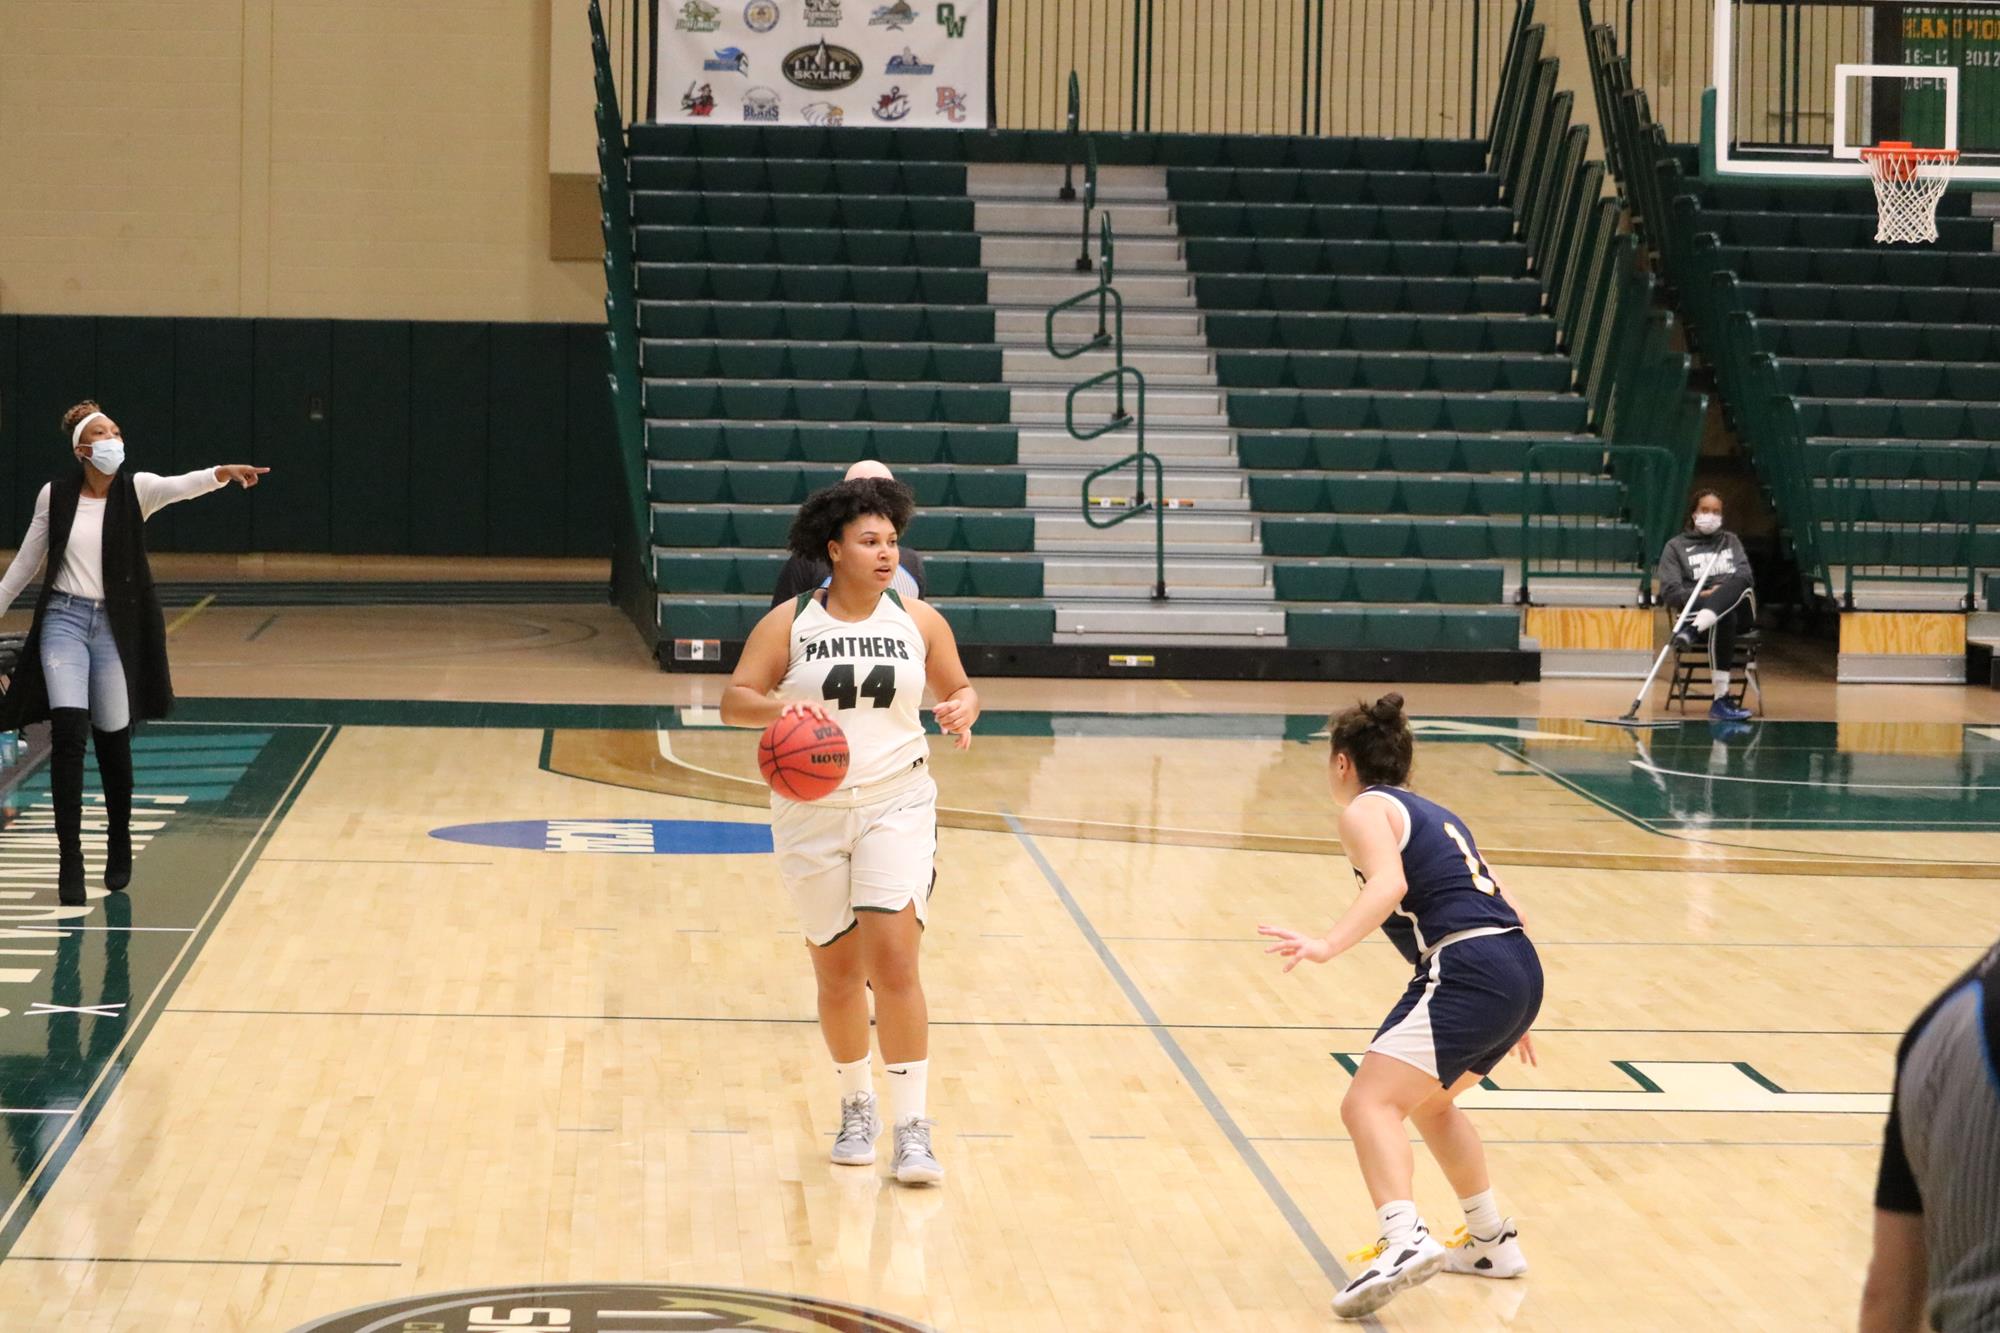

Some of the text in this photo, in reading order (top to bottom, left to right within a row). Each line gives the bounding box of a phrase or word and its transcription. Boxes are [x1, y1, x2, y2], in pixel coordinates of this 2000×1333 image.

[794, 70, 851, 80] SKYLINE
[806, 636, 909, 662] PANTHERS
[822, 664, 896, 710] 44
